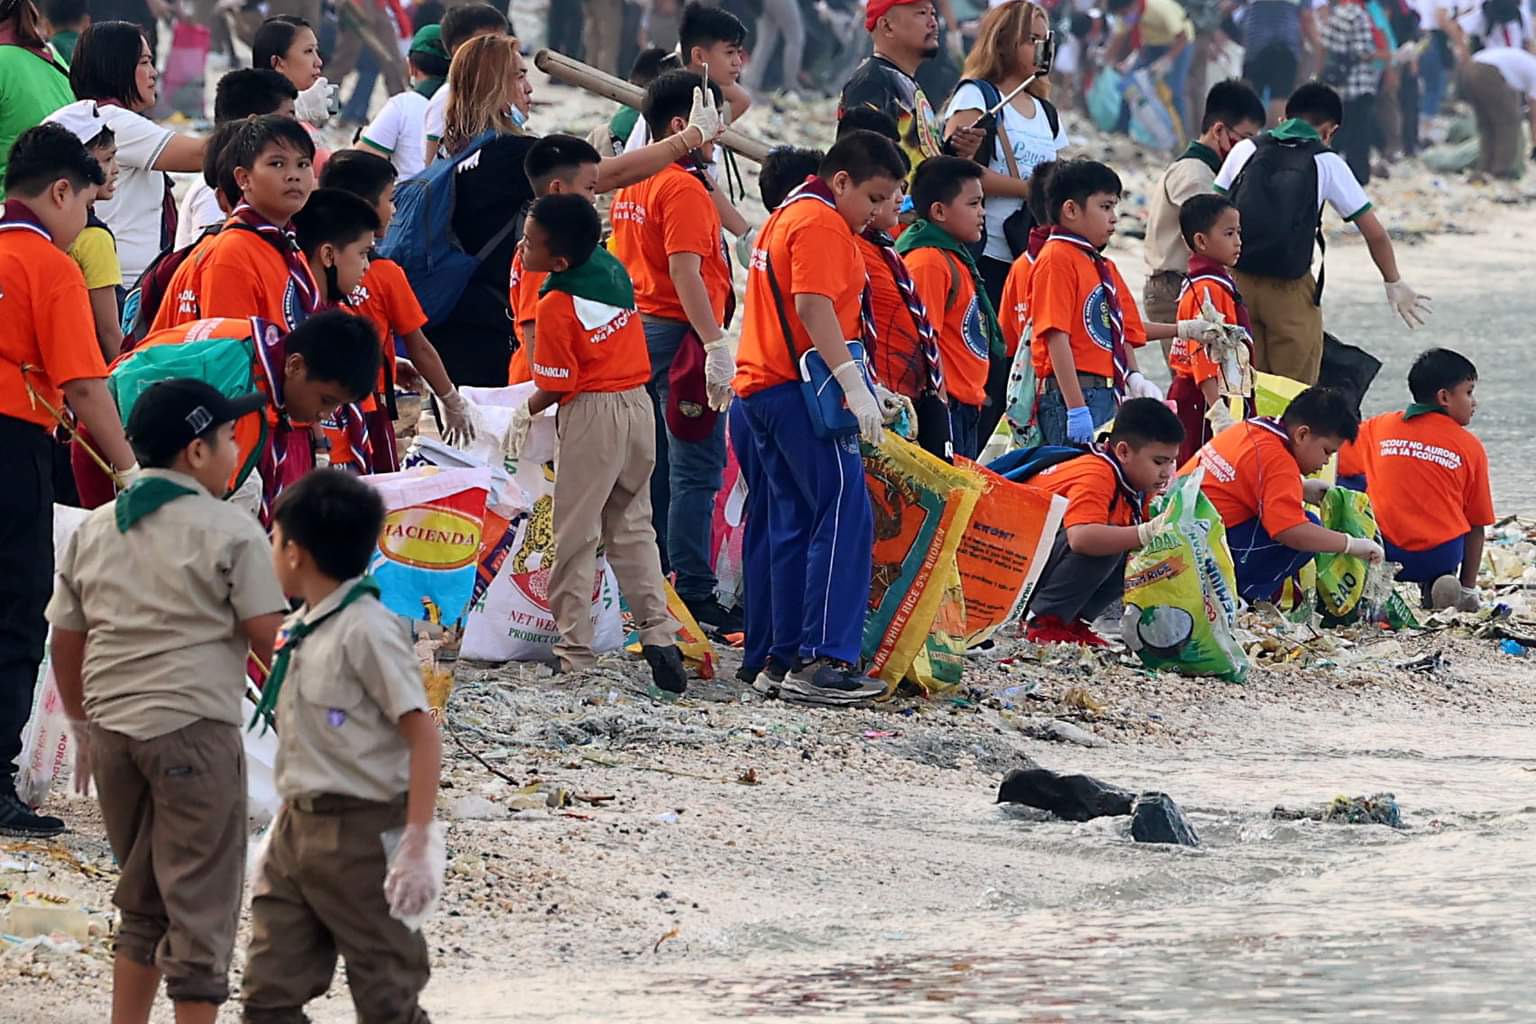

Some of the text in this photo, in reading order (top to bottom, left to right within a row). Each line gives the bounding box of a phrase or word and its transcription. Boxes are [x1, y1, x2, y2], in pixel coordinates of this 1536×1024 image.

[1203, 557, 1236, 630] EMIUM
[508, 627, 550, 642] PRODUCT
[509, 610, 532, 627] NET
[885, 616, 907, 646] WHITE
[902, 591, 920, 617] RICE
